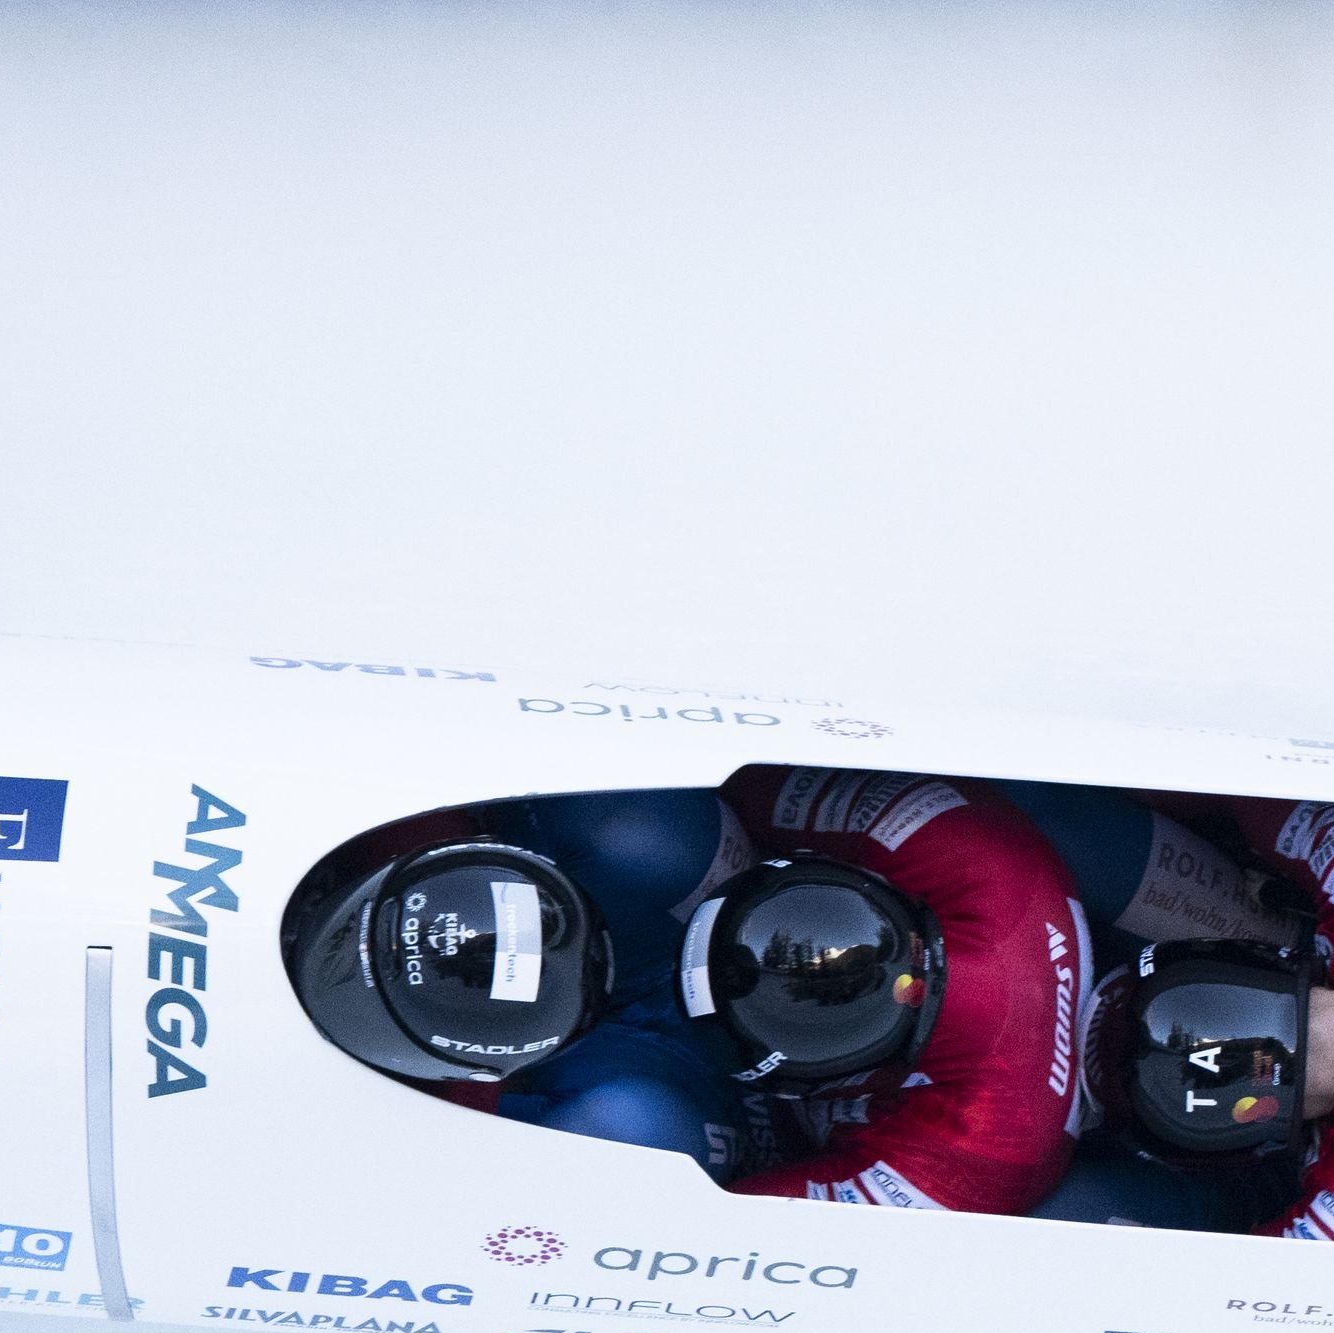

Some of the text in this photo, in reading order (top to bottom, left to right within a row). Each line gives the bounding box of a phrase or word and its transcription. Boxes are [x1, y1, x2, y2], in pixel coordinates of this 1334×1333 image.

[250, 656, 497, 682] KIBAG
[518, 698, 781, 727] aprica
[146, 783, 247, 1099] AMMEGA
[402, 917, 423, 986] aprica
[430, 1035, 560, 1056] STADLER
[730, 1051, 788, 1081] DLER
[1186, 1046, 1222, 1113] T A
[227, 1266, 475, 1306] KIBAG
[593, 1246, 860, 1289] aprica
